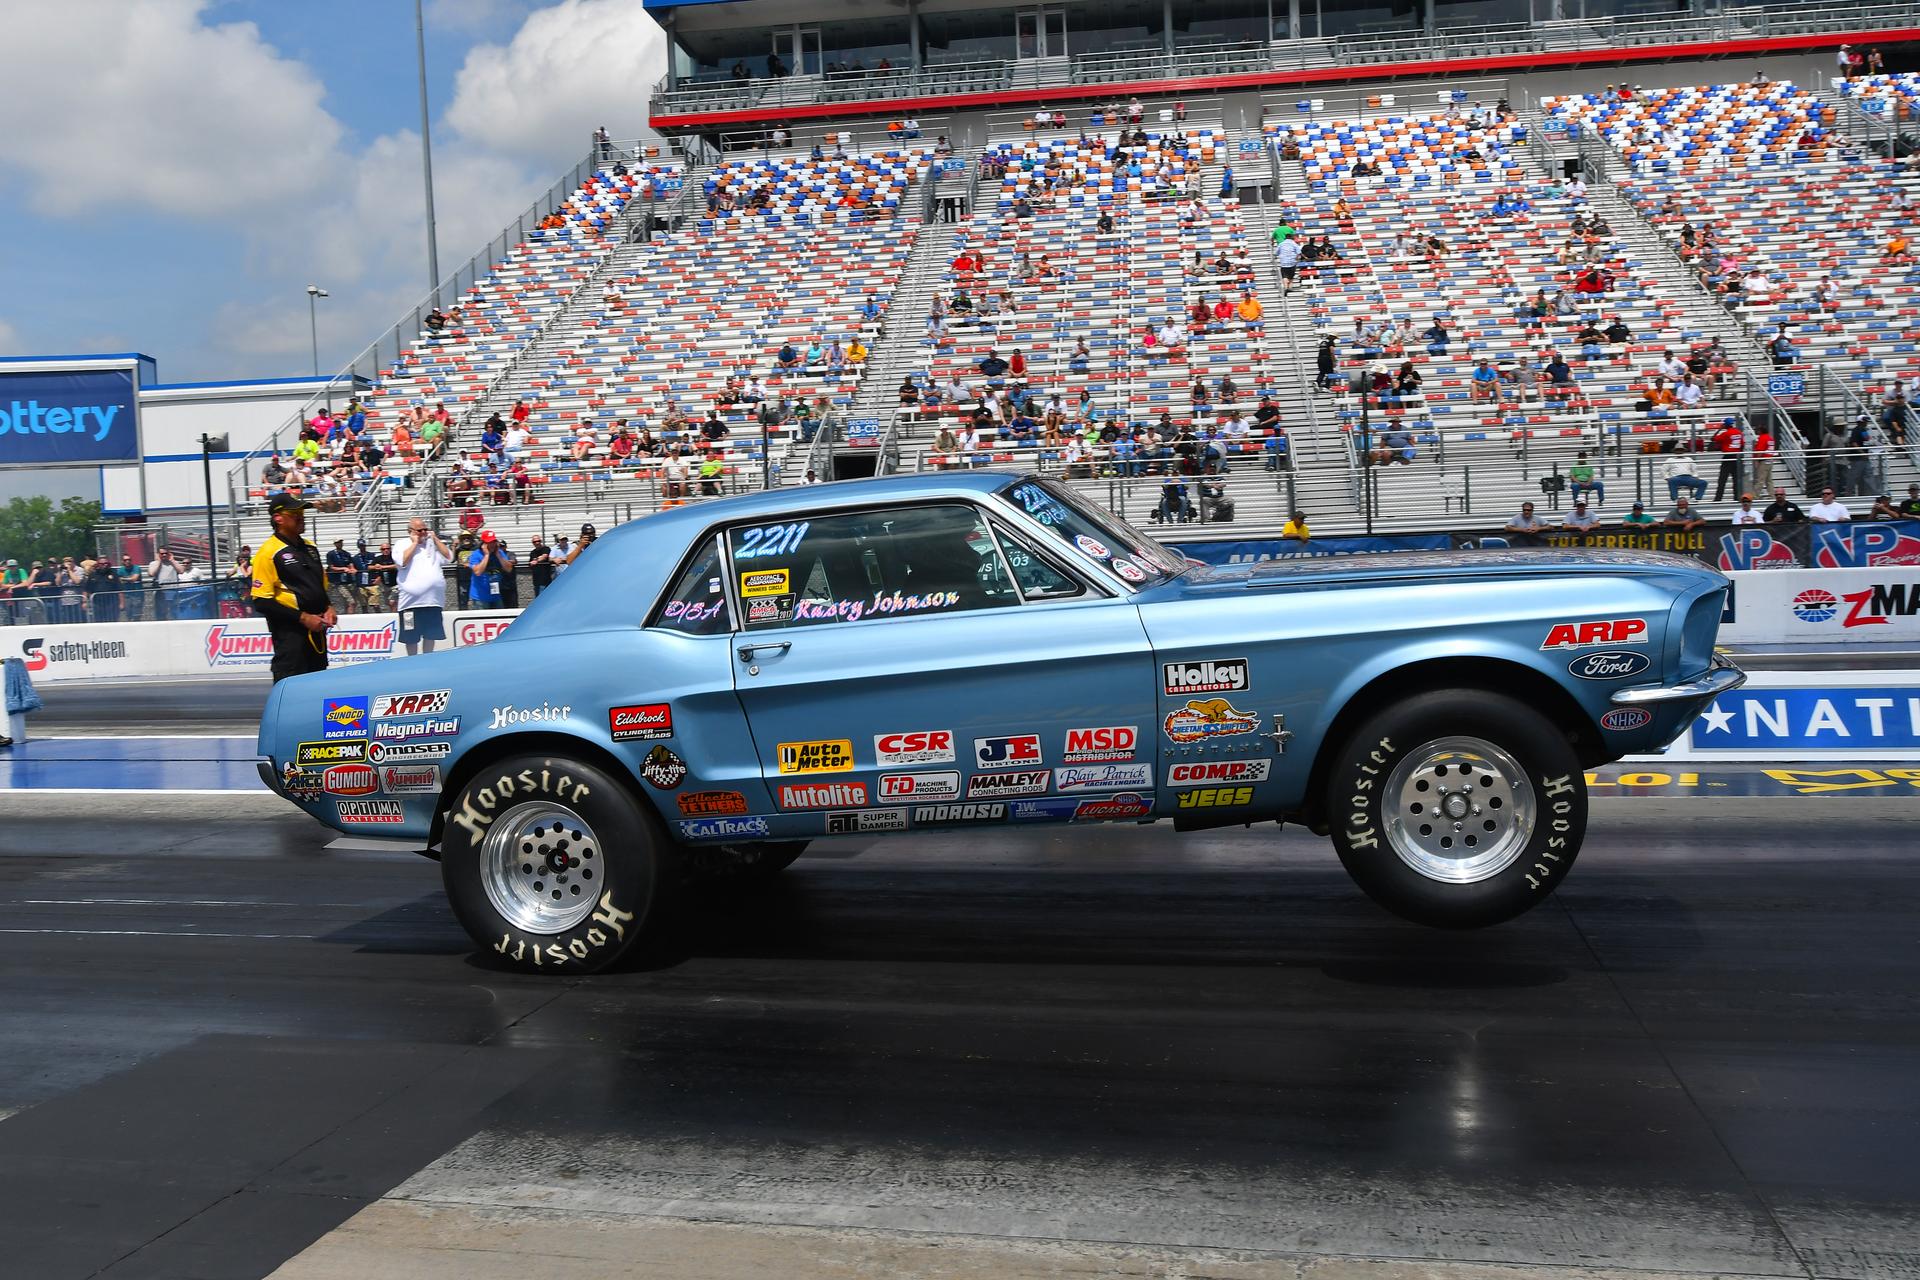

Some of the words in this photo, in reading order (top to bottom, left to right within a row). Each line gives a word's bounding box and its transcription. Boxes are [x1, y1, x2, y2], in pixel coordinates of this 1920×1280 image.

[849, 424, 879, 434] AB-CD
[735, 522, 810, 559] 2211
[1586, 533, 1658, 550] PERFECT
[1664, 532, 1705, 550] FUEL
[1720, 528, 1773, 570] VP
[1819, 524, 1900, 567] VP
[1755, 558, 1801, 566] SMALL
[793, 598, 865, 622] Rusty
[865, 589, 960, 615] Johnson
[208, 627, 273, 658] SUMMI
[329, 627, 393, 651] UMMIT
[1543, 620, 1646, 647] ARP
[1584, 655, 1634, 675] Ford
[1167, 662, 1245, 689] Holley
[1168, 684, 1231, 693] CARBURETORS
[383, 694, 436, 716] XRP
[328, 710, 363, 720] SUNOCO
[488, 702, 571, 730] Hoosier
[615, 711, 666, 726] Edelbrock
[1609, 712, 1643, 726] NHRA
[346, 729, 367, 737] FUELS
[375, 718, 459, 739] MagnaFuel
[613, 729, 654, 737] CYLINDER
[643, 732, 672, 740] HEADS
[878, 732, 950, 753] CSR
[979, 736, 1039, 761] JE
[1067, 728, 1134, 752] MSD
[311, 744, 363, 759] RACEPAK
[386, 743, 450, 756] MOSER
[800, 744, 841, 757] Auto
[1065, 751, 1132, 762] DISTRIBUTOR
[798, 755, 850, 769] Meter
[982, 759, 1039, 768] PISTONS
[328, 770, 374, 790] GUMOUT
[1060, 767, 1097, 786] Blair
[1103, 765, 1146, 780] Patrick
[1173, 763, 1247, 781] COMP
[1223, 773, 1259, 781] CAMS
[915, 780, 948, 788] MACHINE
[915, 785, 953, 793] PRODUCTS
[971, 773, 1036, 790] MANLEY
[783, 784, 866, 808] Autolite
[972, 787, 1020, 797] CONNECTING
[1022, 785, 1044, 793] RODS
[1178, 787, 1254, 808] JEGS
[1346, 736, 1396, 850] Hoosier
[339, 801, 401, 815] OPTIMA
[453, 760, 591, 848] Hoosier
[680, 799, 744, 813] TETHERS
[914, 803, 1005, 822] MOROSO
[1082, 806, 1121, 815] LUCAS
[1122, 805, 1141, 813] OIL
[860, 821, 905, 830] DAMPER
[863, 812, 898, 822] SUPER
[1525, 773, 1576, 890] Hoosier
[493, 889, 634, 966] Hoosier
